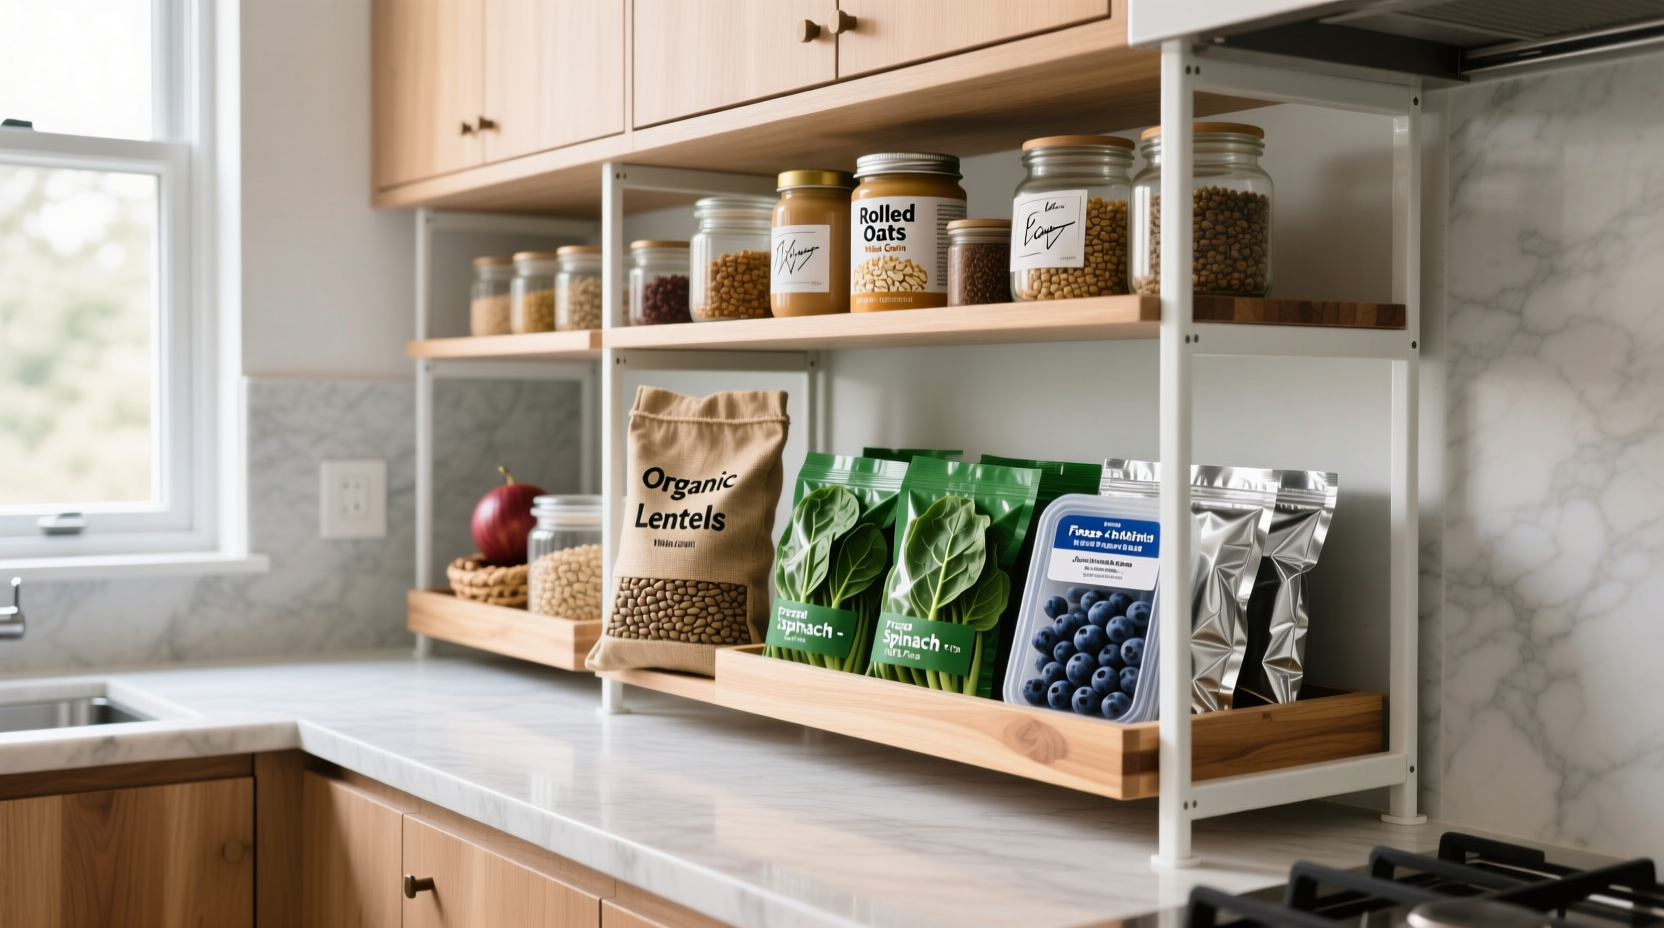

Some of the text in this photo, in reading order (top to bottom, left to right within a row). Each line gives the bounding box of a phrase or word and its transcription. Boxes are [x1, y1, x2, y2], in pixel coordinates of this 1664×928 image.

[860, 203, 915, 225] Rolled
[863, 224, 907, 242] Oats
[642, 466, 738, 501] Organic
[634, 502, 726, 532] Lentels
[882, 629, 940, 653] Spinach
